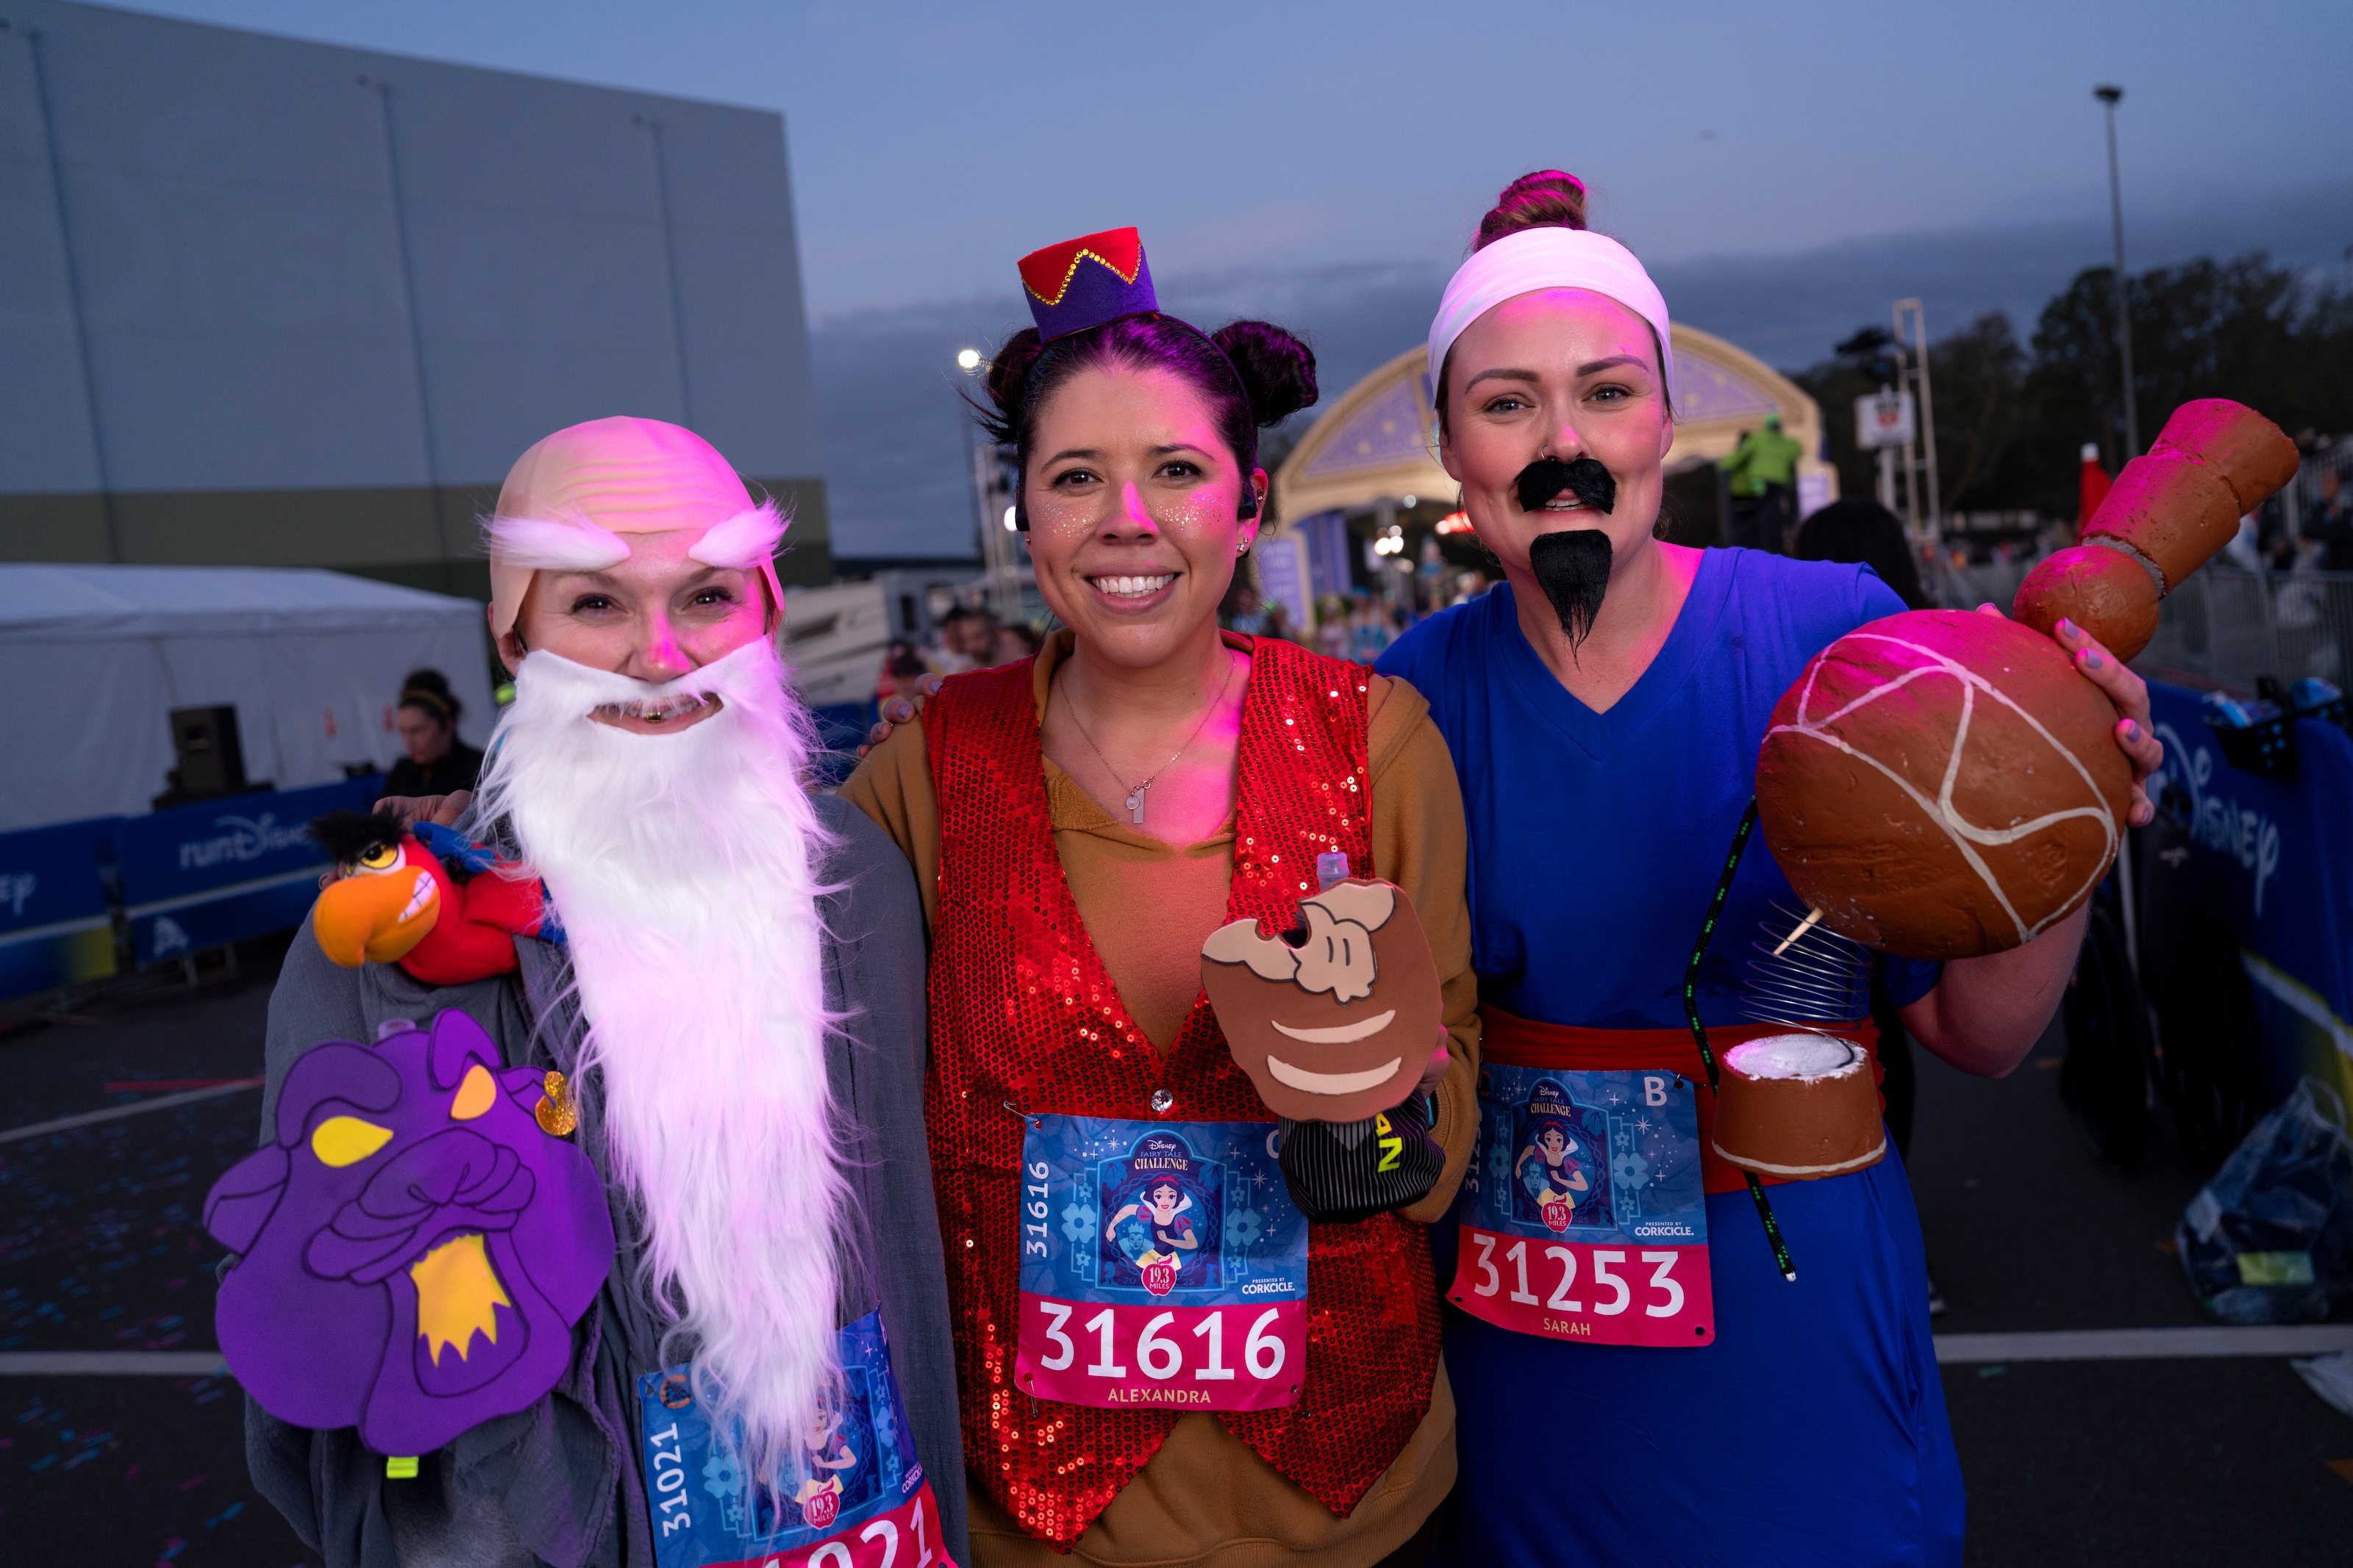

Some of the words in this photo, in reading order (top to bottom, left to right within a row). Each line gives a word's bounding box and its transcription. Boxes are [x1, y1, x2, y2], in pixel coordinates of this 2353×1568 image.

[1644, 1076, 1668, 1107] B
[1530, 1103, 1571, 1117] CHALLENGE
[1134, 1157, 1188, 1171] CHALLENGE
[1026, 1161, 1050, 1259] 31616
[1547, 1205, 1567, 1221] 19.3
[1123, 1276, 1137, 1285] 20
[1149, 1267, 1170, 1284] 19.3
[1182, 1278, 1195, 1286] 25
[1473, 1233, 1685, 1318] 31253
[1543, 1317, 1591, 1336] SARAH
[1039, 1300, 1287, 1381] 31616
[1107, 1387, 1212, 1404] ALEXANDRA
[649, 1422, 691, 1538] 31021
[810, 1494, 834, 1517] 19.3
[813, 1511, 835, 1524] MILES
